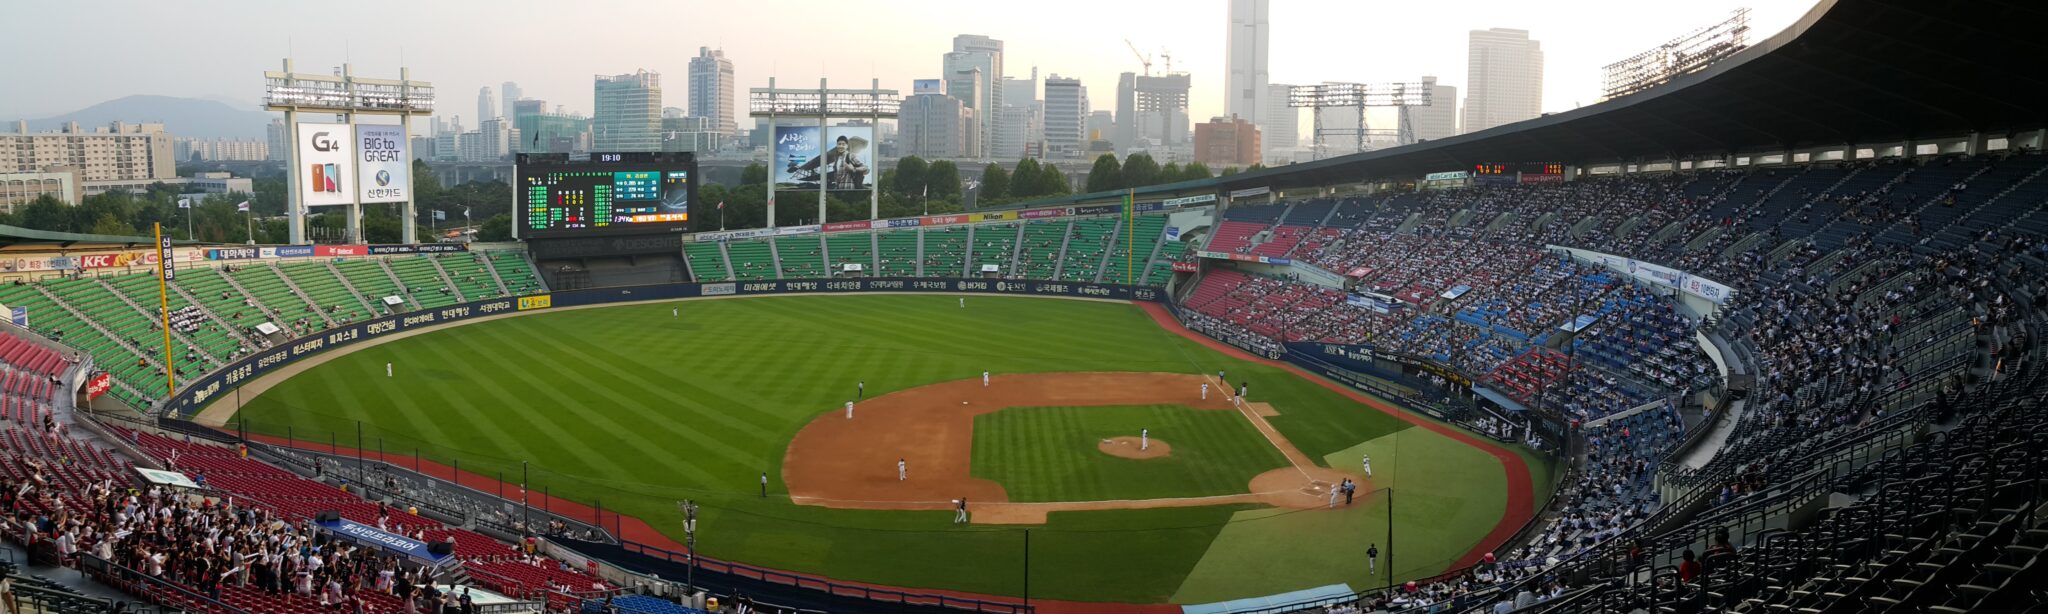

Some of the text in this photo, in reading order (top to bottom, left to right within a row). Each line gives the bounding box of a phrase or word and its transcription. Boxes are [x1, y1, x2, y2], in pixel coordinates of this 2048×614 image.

[312, 132, 339, 152] G4
[364, 138, 395, 150] BIG to
[365, 150, 400, 162] GREAT
[601, 154, 621, 162] 19:10
[368, 189, 400, 198] 신한카드
[220, 249, 255, 259] 대화제약
[83, 255, 110, 268] KFC
[743, 282, 776, 291] 미래에셋
[786, 282, 817, 290] 현대해상
[826, 281, 861, 290] 다비치안경
[913, 281, 947, 289] 우체국보험
[967, 282, 987, 290] 버거킹
[225, 363, 252, 385] 키움증권
[367, 320, 396, 335] 대방건설
[442, 306, 469, 319] 현대해상
[341, 523, 420, 551] 두산인프라코어
